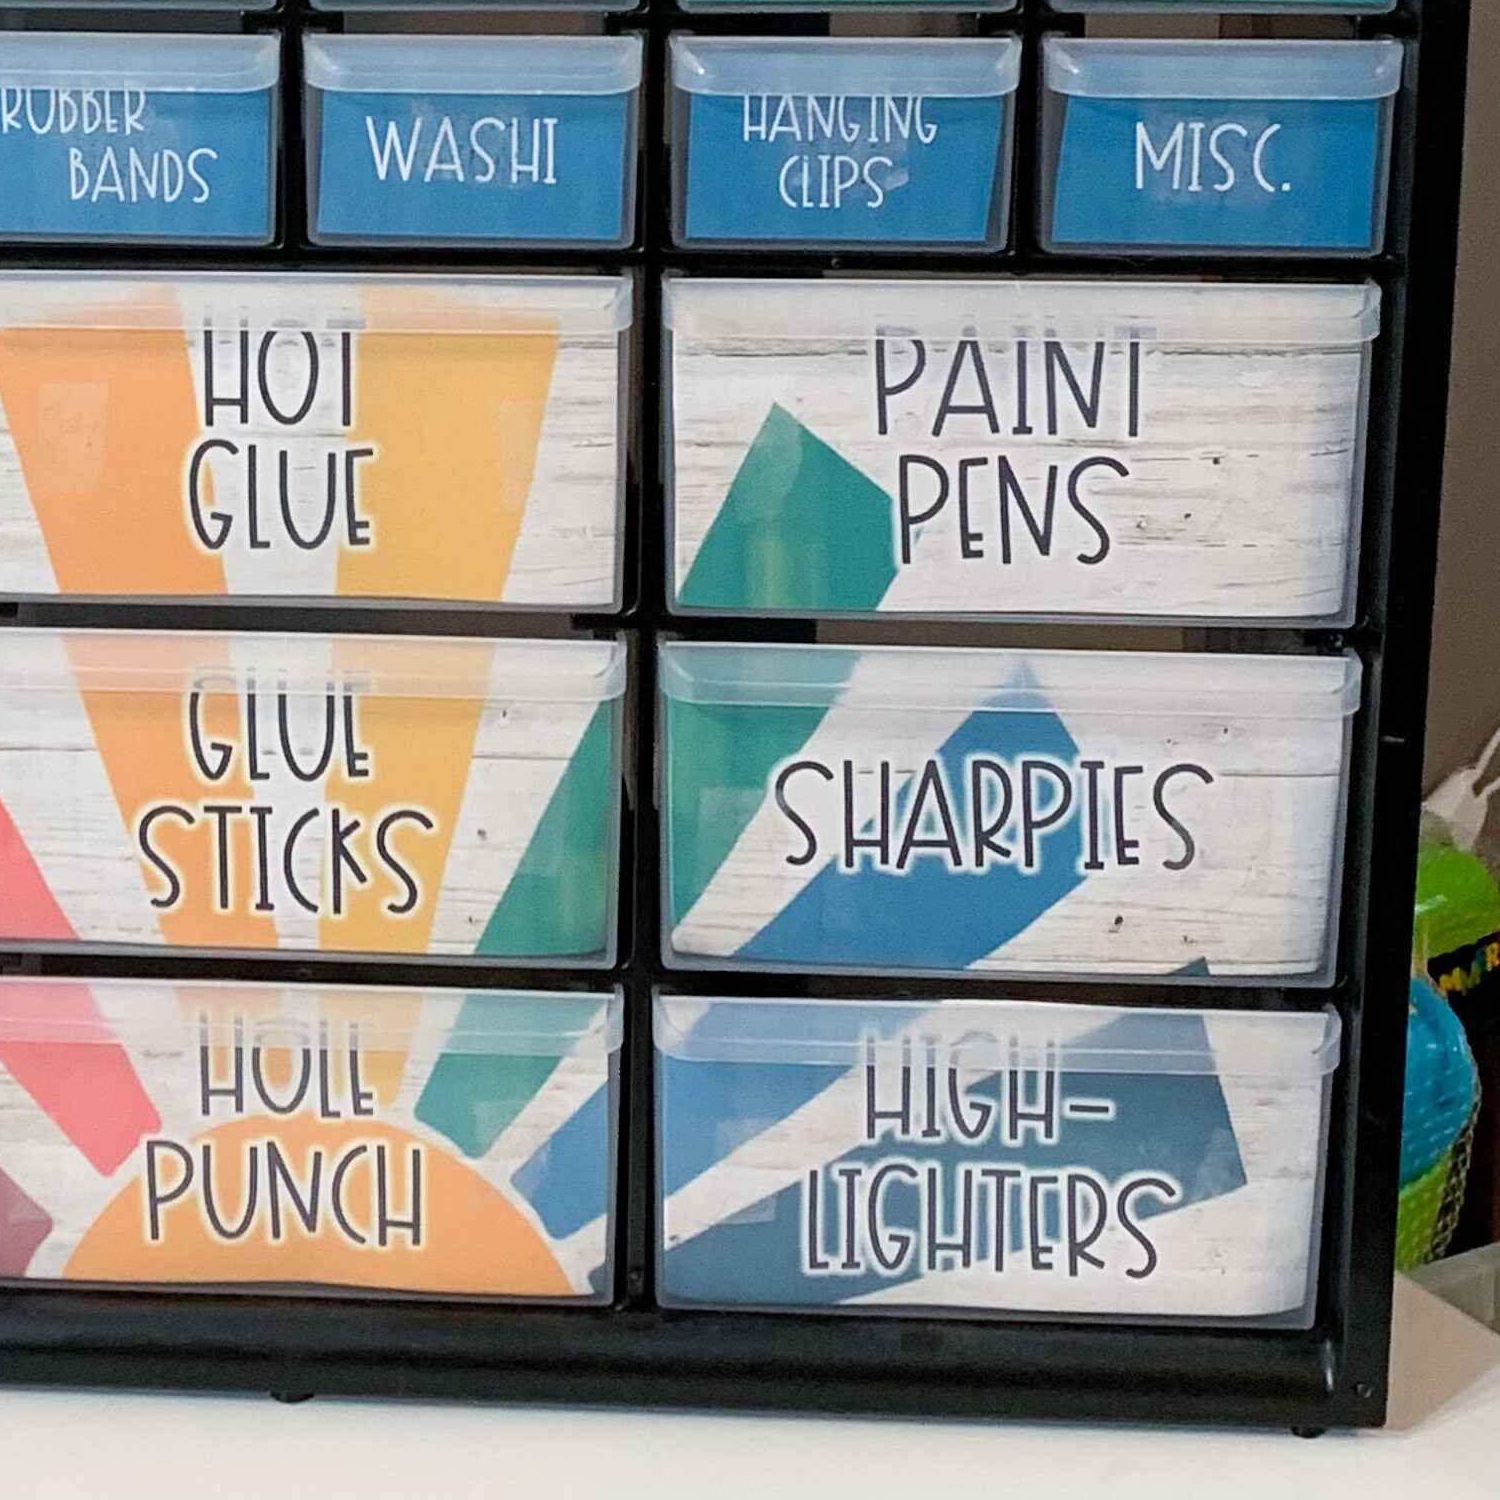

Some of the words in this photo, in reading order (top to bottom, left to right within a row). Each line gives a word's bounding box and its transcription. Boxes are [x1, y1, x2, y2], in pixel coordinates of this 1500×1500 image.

[2, 85, 147, 135] RUBBER
[365, 115, 558, 183] WASHI
[743, 93, 937, 145] HANGING
[1135, 121, 1291, 192] MISC.
[70, 148, 217, 203] BANDS
[779, 154, 894, 208] CLIPS
[202, 306, 366, 429] HOT
[874, 324, 1156, 438] PAINT
[189, 438, 373, 550] GLUE
[899, 453, 1130, 566] PENS
[189, 672, 371, 781] GLUE
[140, 805, 434, 915] STICKS
[776, 757, 1213, 871] SHARPIES
[199, 1010, 374, 1117] HOLE
[863, 1029, 1112, 1141] HIGH-
[146, 1139, 421, 1247] PUNCH
[806, 1162, 1176, 1279] LIGHTERS
